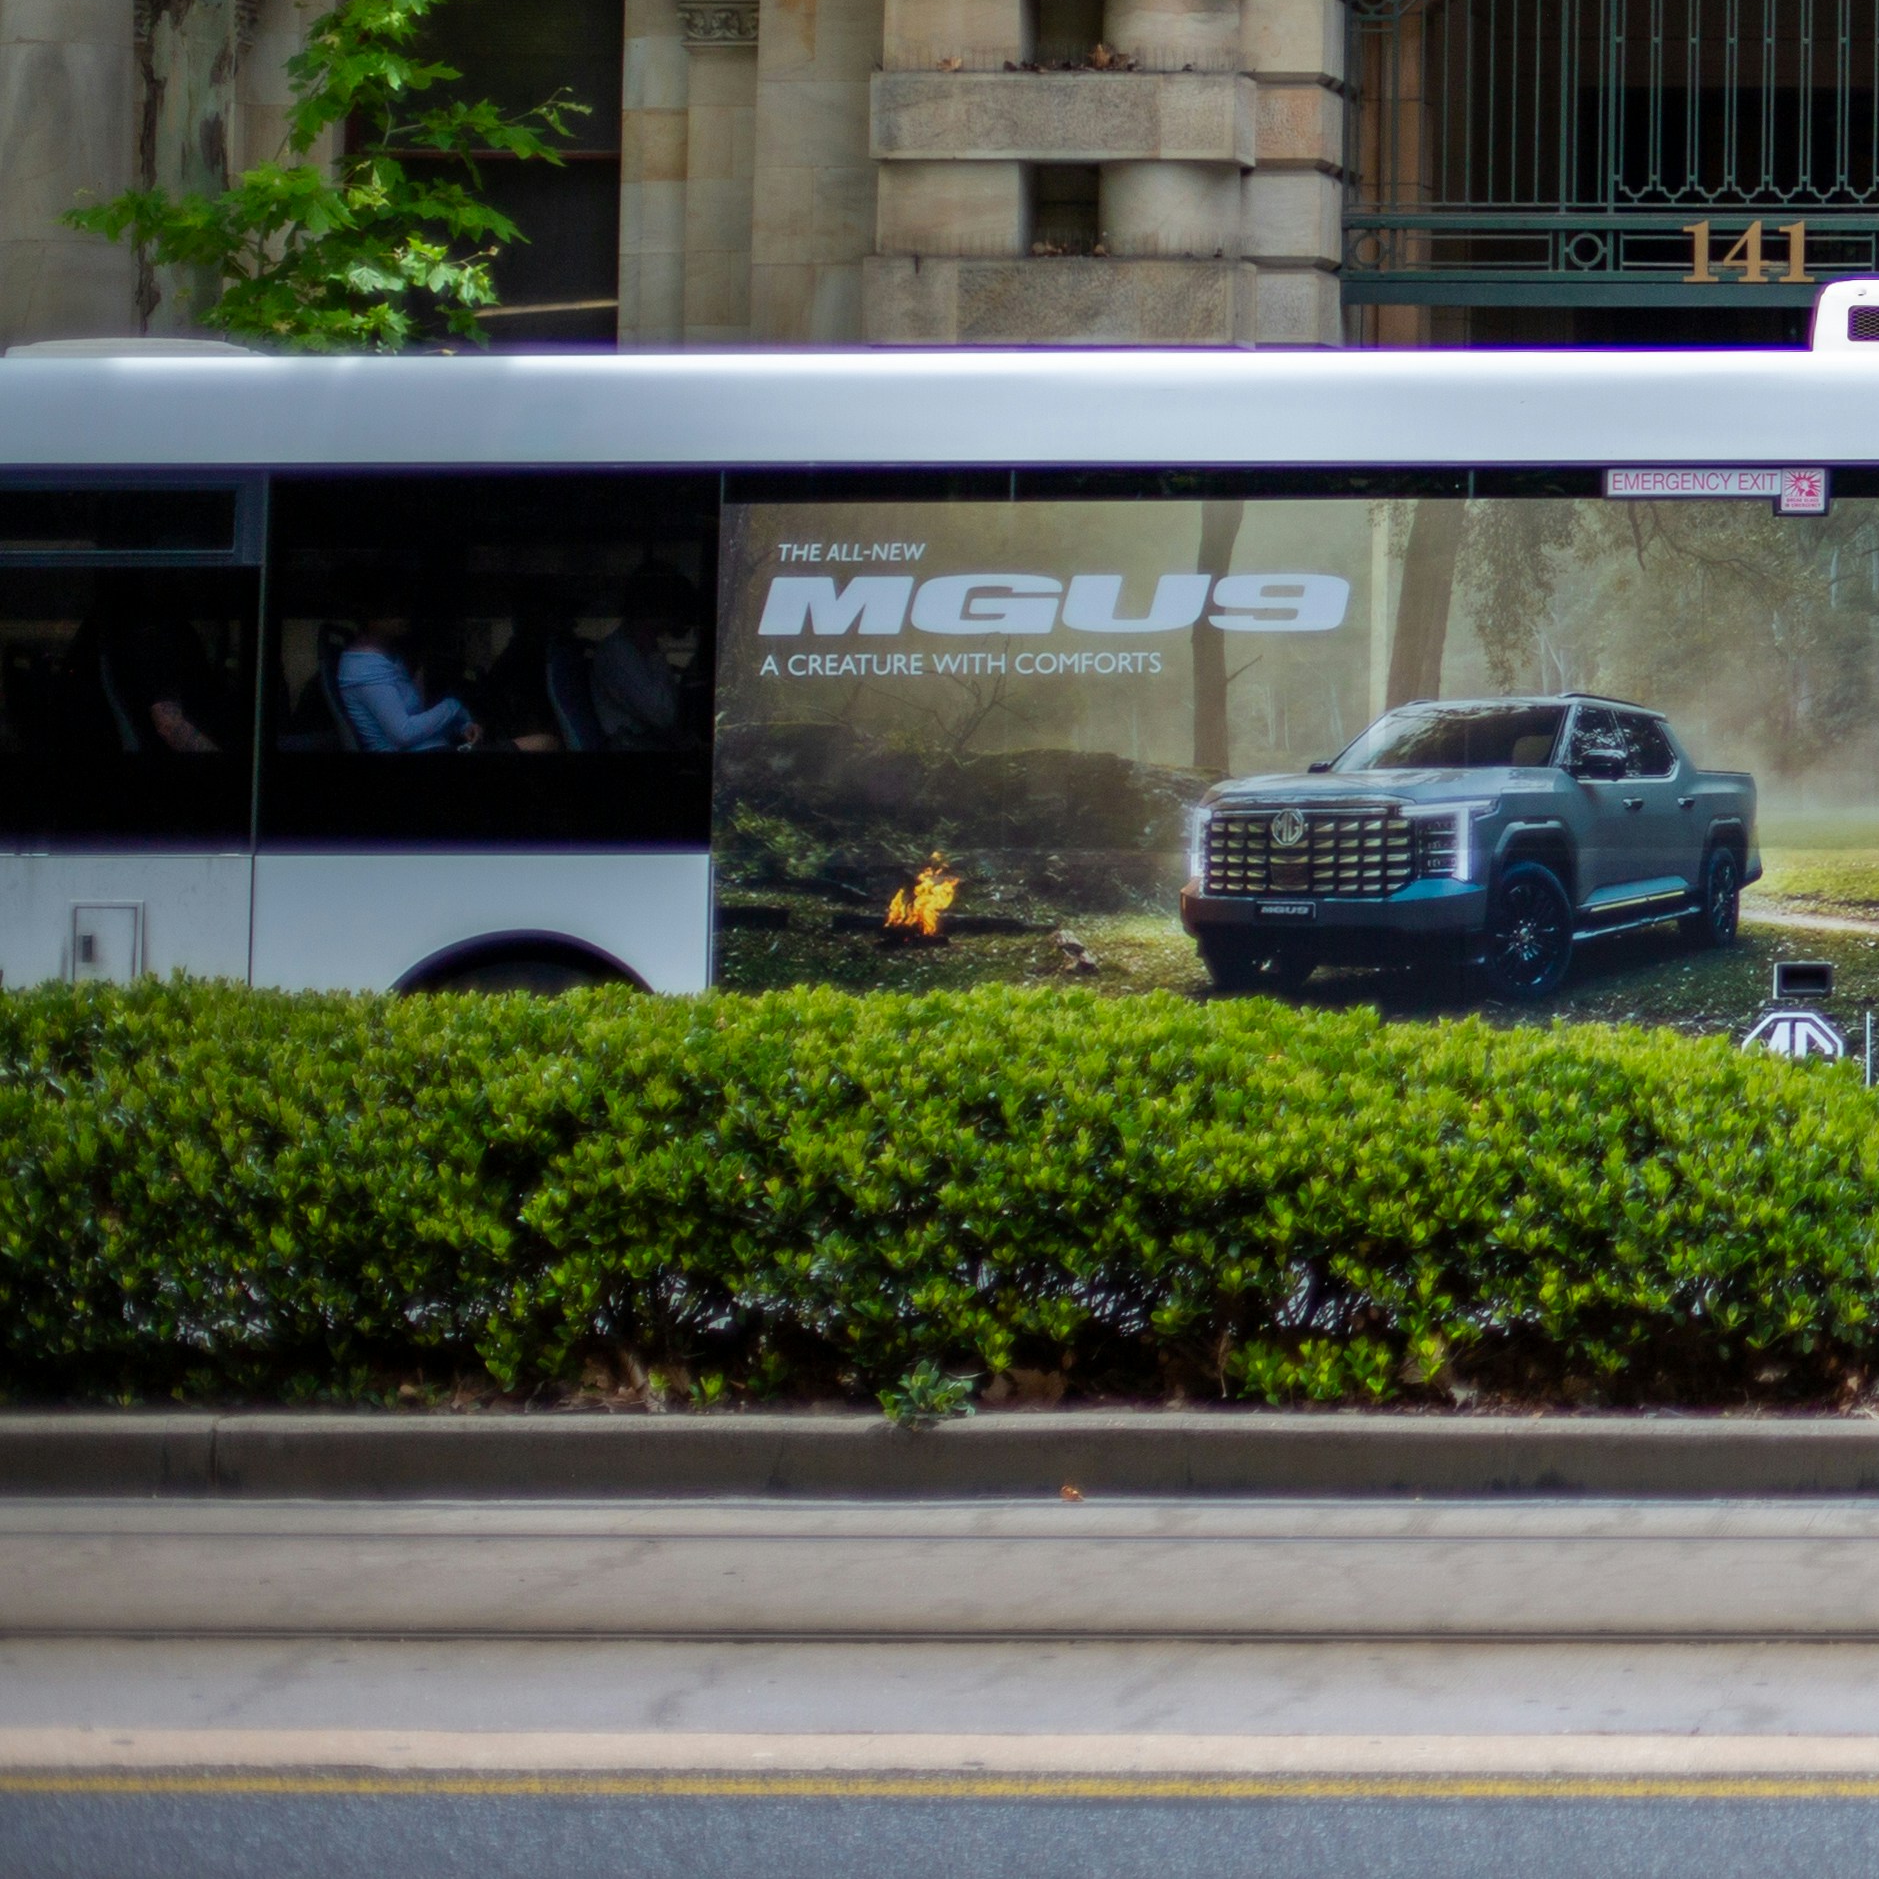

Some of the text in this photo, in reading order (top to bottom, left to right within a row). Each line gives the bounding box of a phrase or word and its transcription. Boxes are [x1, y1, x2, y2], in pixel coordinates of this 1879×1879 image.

[1682, 220, 1815, 283] 141
[1612, 472, 1778, 491] EMERGENCY EXIT
[778, 542, 927, 562] THE ALL-NEW
[757, 573, 1351, 636] MGU9
[759, 651, 1163, 677] A CREATURE WITH COMFORTS
